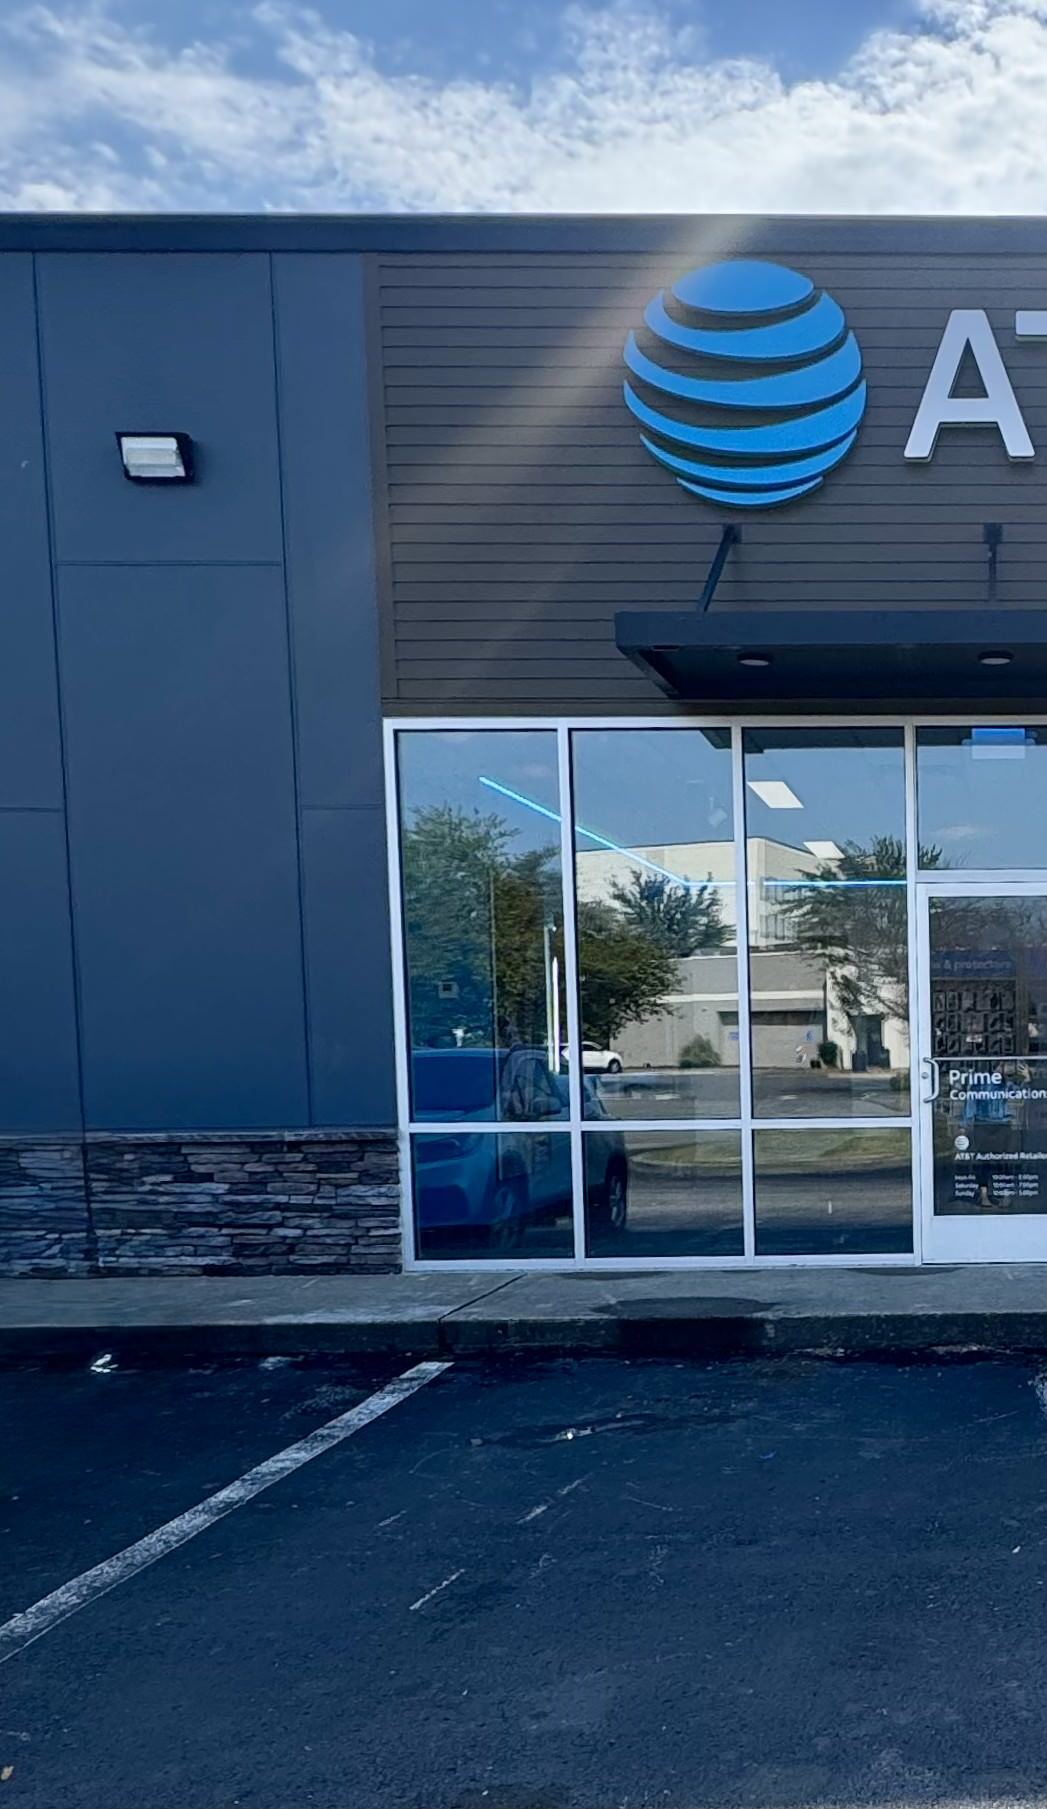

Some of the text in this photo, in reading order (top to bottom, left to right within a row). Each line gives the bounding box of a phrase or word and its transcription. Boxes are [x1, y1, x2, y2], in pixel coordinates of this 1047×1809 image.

[949, 1069, 1003, 1085] Prime
[954, 1151, 975, 1160] AT&T
[976, 1151, 1019, 1160] Authorized
